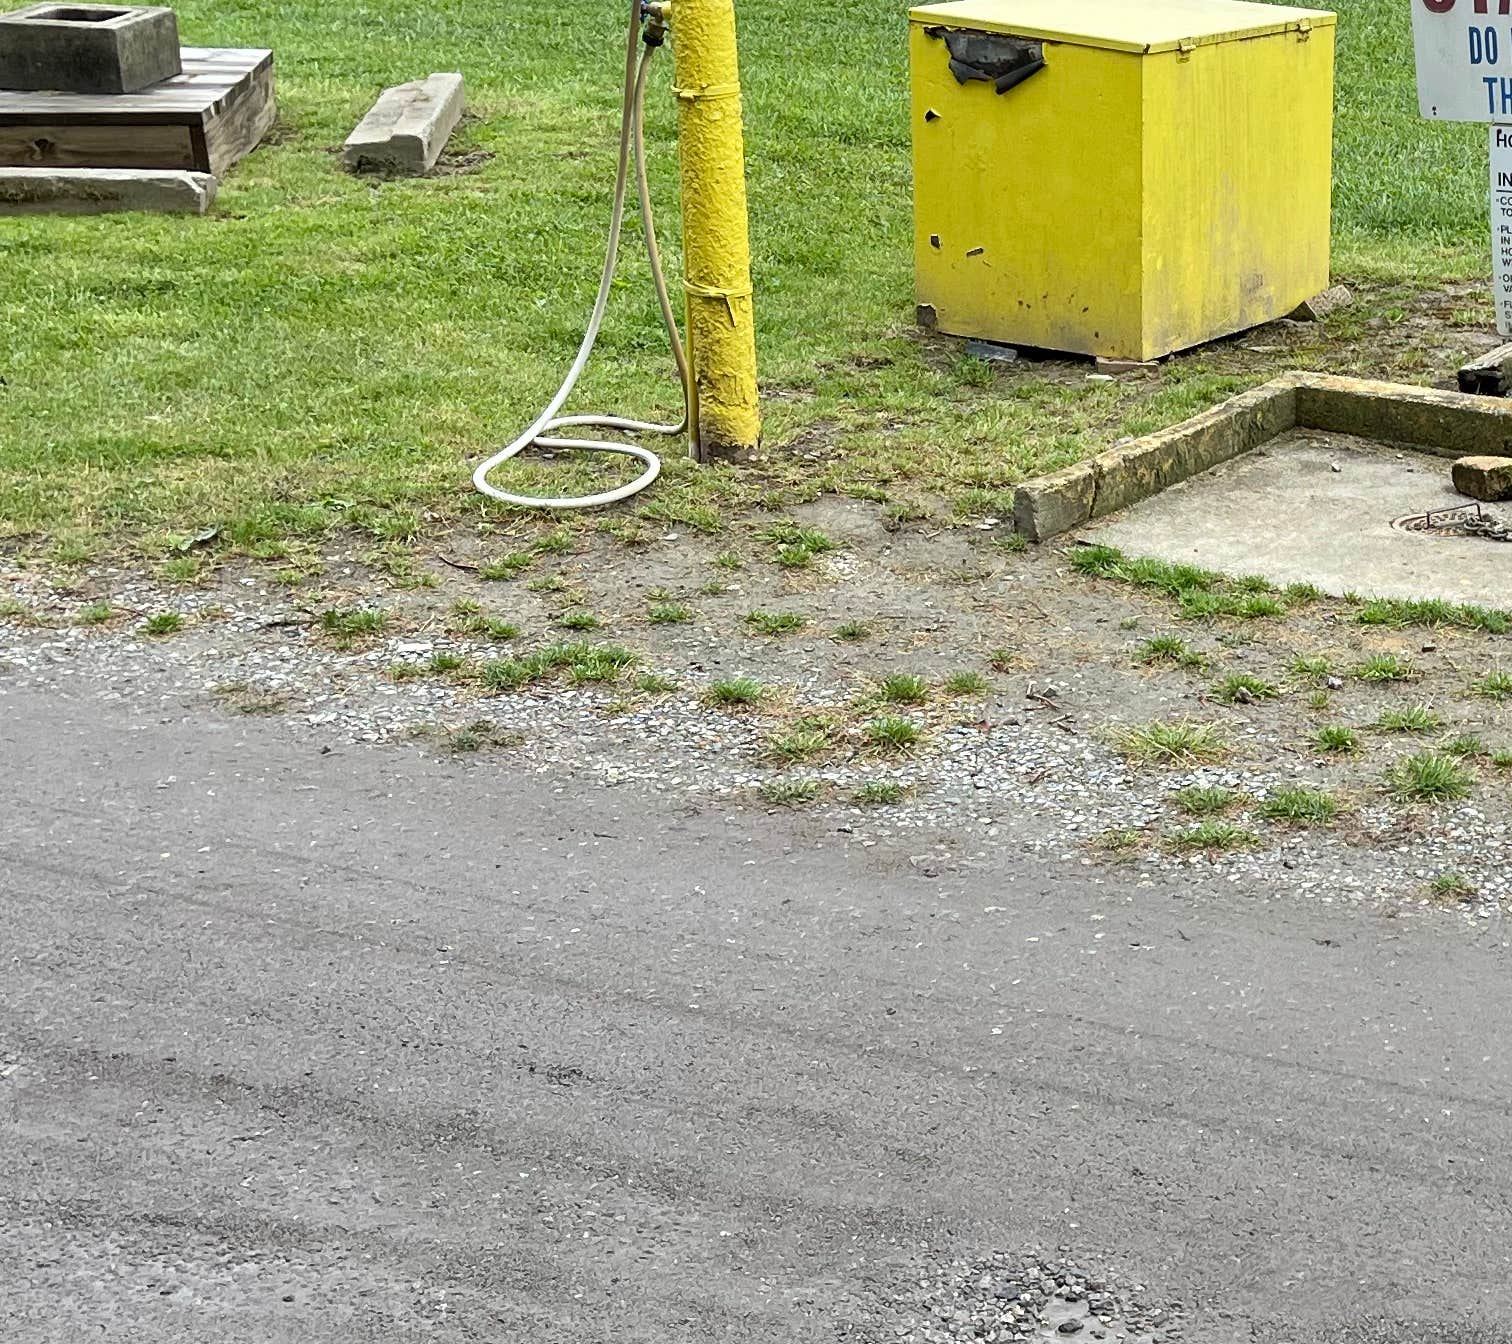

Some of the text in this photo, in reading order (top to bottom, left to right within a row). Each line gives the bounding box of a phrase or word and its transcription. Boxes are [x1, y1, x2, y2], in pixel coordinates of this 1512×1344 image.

[1468, 26, 1498, 65] DO
[1501, 208, 1512, 217] TO
[1501, 236, 1510, 245] IN
